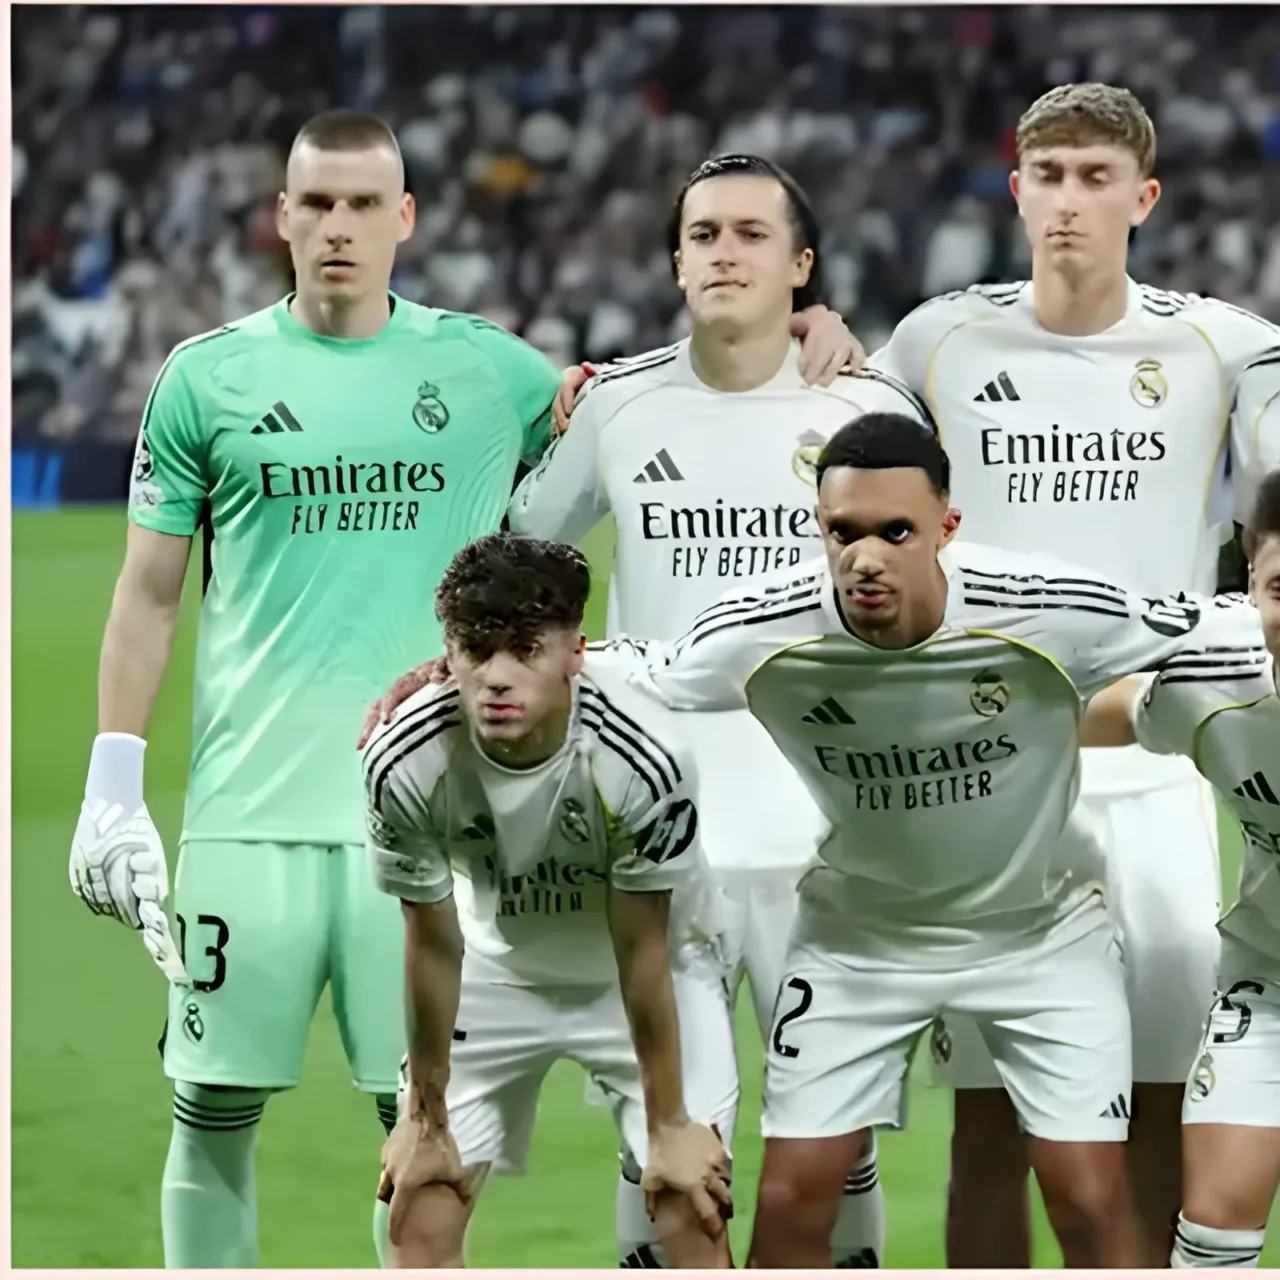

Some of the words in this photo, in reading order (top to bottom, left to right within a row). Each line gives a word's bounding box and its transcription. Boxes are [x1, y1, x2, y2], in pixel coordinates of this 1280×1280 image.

[980, 424, 1166, 466] Emirates
[259, 454, 446, 498] Emirates
[1007, 472, 1044, 503] FLY
[1053, 470, 1139, 503] BETTER
[291, 503, 328, 535] FLY
[336, 501, 420, 531] BETTER
[640, 498, 823, 540] Emirate
[672, 547, 708, 577] FLY
[814, 734, 1017, 780] Emirates
[856, 782, 892, 810] FLY
[904, 770, 992, 810] BETTER
